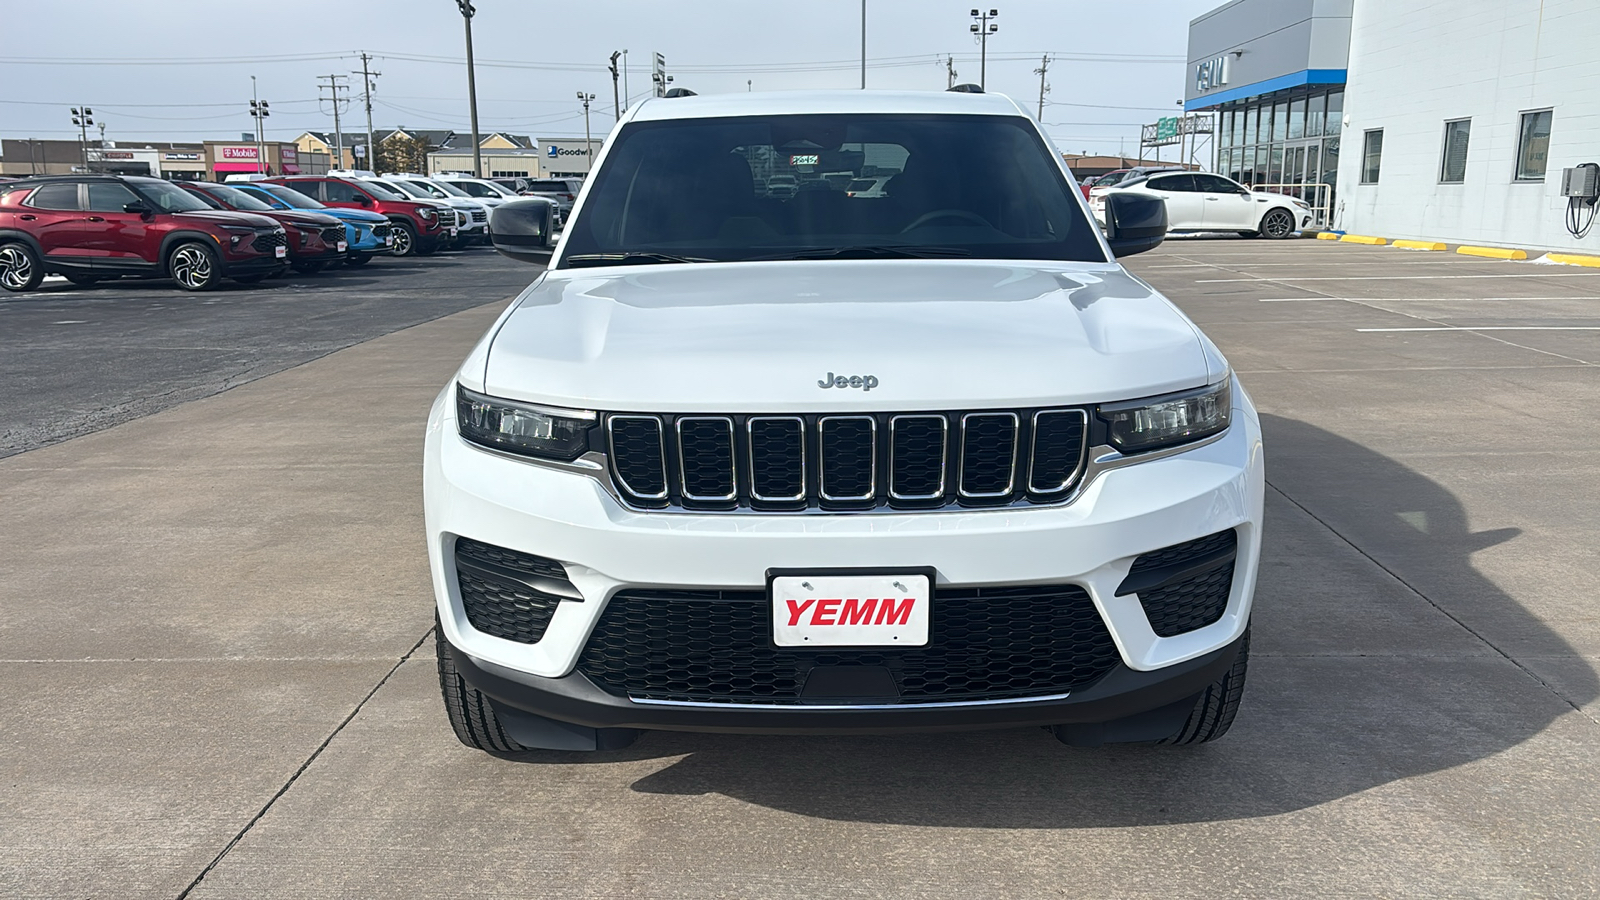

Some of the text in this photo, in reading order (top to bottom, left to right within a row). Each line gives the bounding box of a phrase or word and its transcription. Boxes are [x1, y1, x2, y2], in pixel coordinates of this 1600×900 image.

[557, 148, 593, 156] Goodwl
[817, 371, 879, 392] Jeep
[785, 598, 916, 626] YEMM
